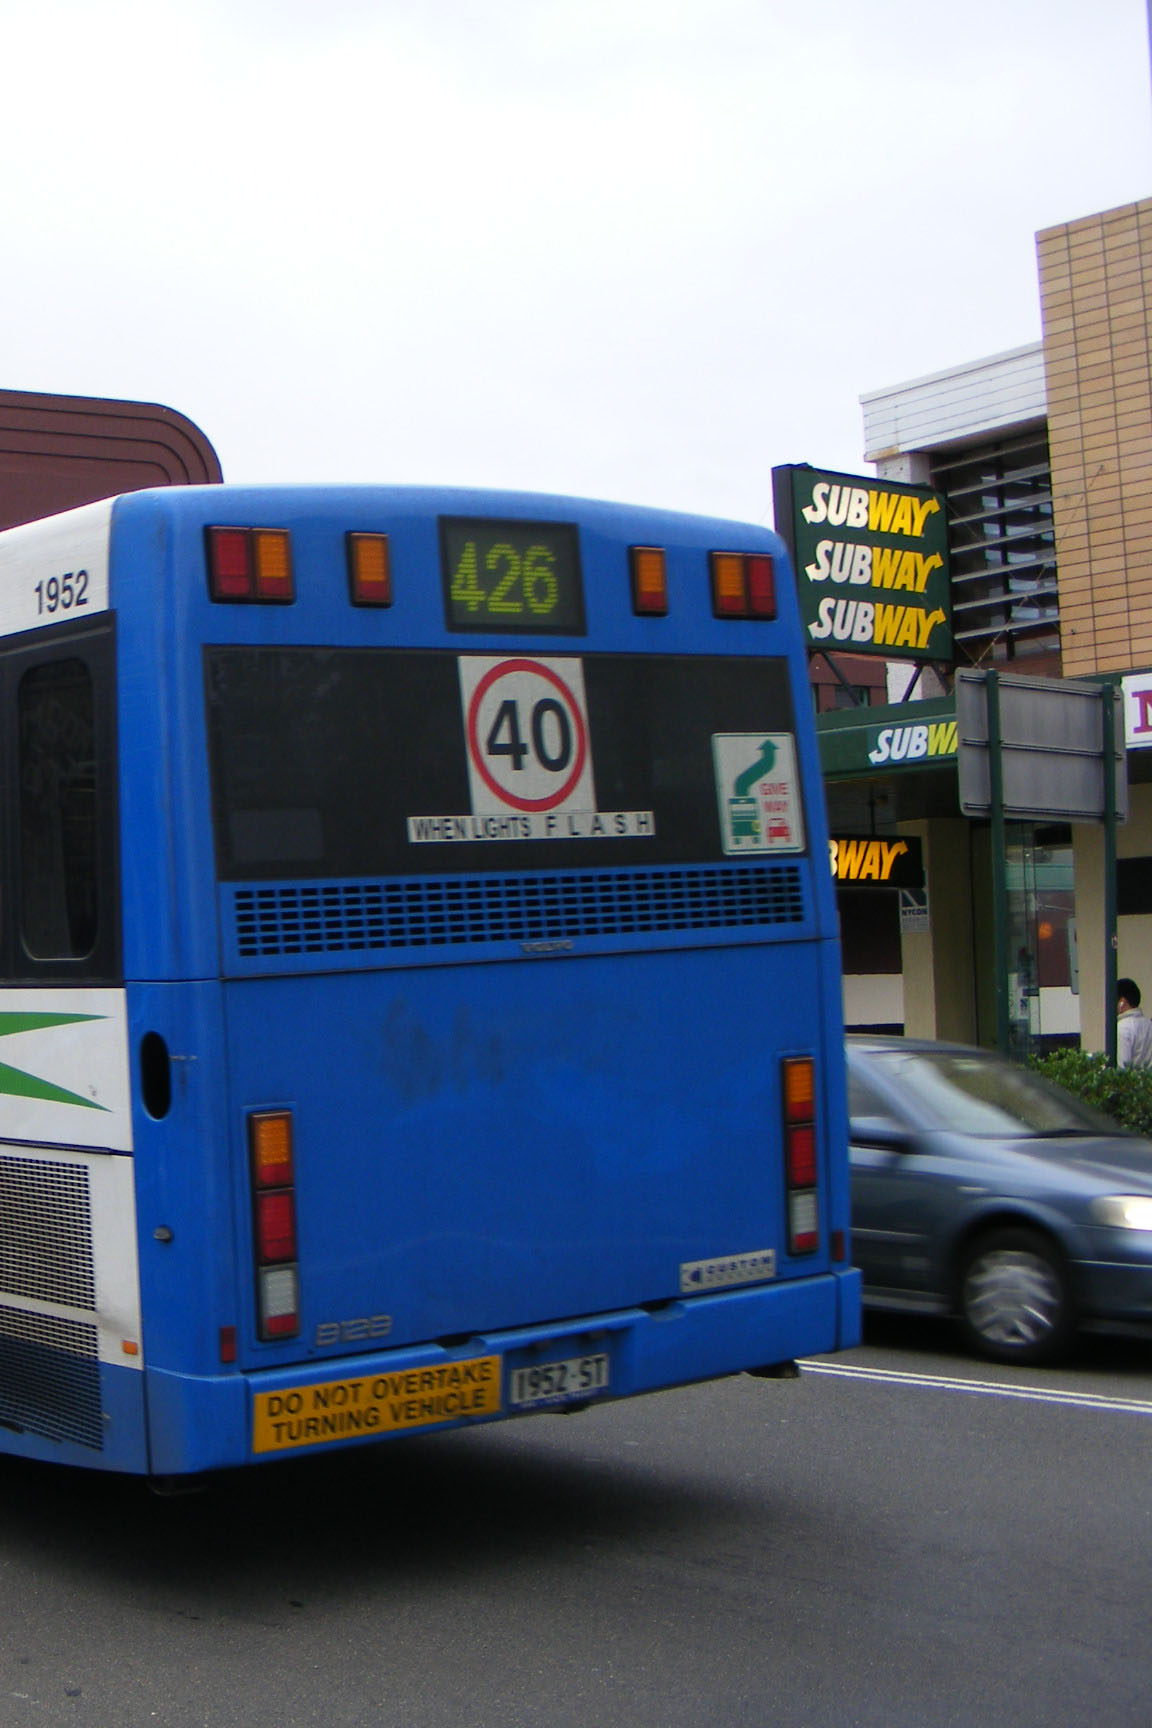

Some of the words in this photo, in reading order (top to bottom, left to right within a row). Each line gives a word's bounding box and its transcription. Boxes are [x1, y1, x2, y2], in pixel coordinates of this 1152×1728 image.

[802, 482, 940, 537] SUBWAY
[34, 569, 89, 615] 1952
[450, 541, 559, 614] 426
[805, 539, 944, 593] SUBWAY
[808, 597, 946, 649] SUBWAY
[487, 698, 572, 772] 40
[760, 782, 789, 796] GIVE
[413, 817, 466, 840] WHEN
[471, 816, 532, 839] LIGHTS
[267, 1393, 308, 1418] DO
[314, 1382, 361, 1411] NOT
[371, 1361, 493, 1400] OVERTAKE
[272, 1403, 380, 1443] TURNING
[390, 1388, 486, 1424] VEHICLE
